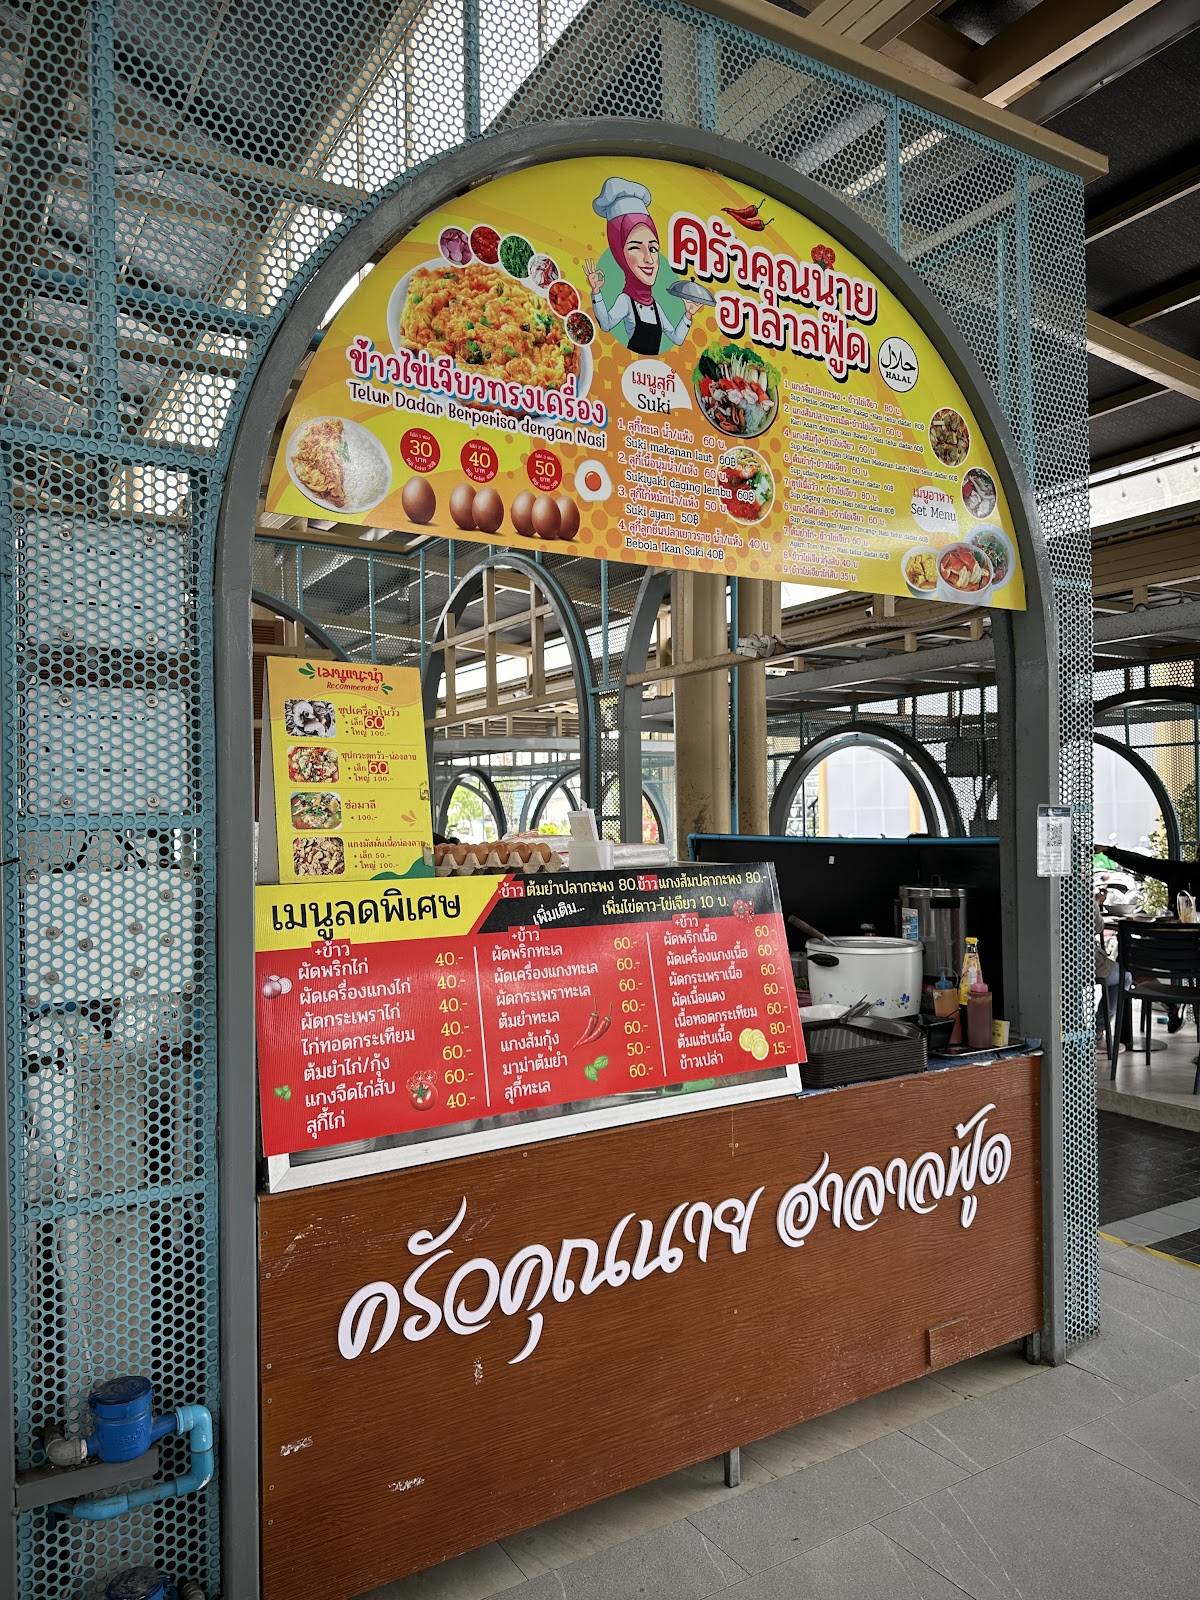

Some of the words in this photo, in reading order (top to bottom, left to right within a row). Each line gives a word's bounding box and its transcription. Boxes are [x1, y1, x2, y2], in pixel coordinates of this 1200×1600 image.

[673, 217, 873, 316] ครัวคุณนาย
[720, 296, 866, 374] ฮาลาลฟู๊ด
[881, 344, 917, 371] حلال
[350, 339, 606, 424] ข้าวไข่เจียวทรงเครื่อง
[632, 369, 676, 397] เมนูสุกี้
[886, 371, 912, 384] HALAL
[350, 382, 390, 405] Telur
[396, 392, 443, 416] Dadar
[449, 403, 516, 430] Berperisa
[521, 420, 572, 442] dengan
[577, 431, 606, 449] Nasi
[637, 394, 671, 414] Suki
[820, 401, 838, 410] dengan
[628, 417, 659, 435] สุกี้ทะเล
[662, 422, 693, 443] น้ำ/แห้ง
[703, 436, 714, 447] 60
[410, 439, 432, 457] 30
[469, 451, 491, 468] 40
[626, 437, 646, 450] Suki
[650, 443, 692, 459] makanan
[695, 450, 713, 463] laut
[535, 460, 555, 477] 50
[704, 469, 716, 479] 60
[626, 471, 666, 487] Sukiyaki
[669, 478, 700, 494] daging
[704, 484, 731, 497] lembu
[914, 487, 954, 504] เมนูอาหาร
[618, 486, 627, 496] 3.
[705, 501, 716, 511] 50
[626, 504, 646, 516] Suki
[650, 509, 675, 521] ayam
[911, 503, 928, 516] Set
[930, 506, 956, 521] Menu
[618, 519, 625, 530] 4.
[749, 539, 760, 549] 40
[626, 537, 658, 551] Bebola
[661, 542, 681, 554] Ikan
[684, 546, 704, 557] Suki
[317, 666, 384, 684] เมนูแนะนำ
[326, 681, 380, 692] Recommended
[364, 716, 384, 729] 60
[368, 761, 389, 774] 60
[527, 879, 614, 896] ต้มยำปลากะพง
[638, 875, 658, 891] ข้าว
[659, 873, 742, 889] แกงส้มปลากะพง
[745, 872, 767, 884] 80.-
[272, 888, 461, 941] เมนูลดพิเศษ
[532, 901, 585, 926] เพิ่มเติม...
[602, 895, 697, 916] เพิ่มไข่ดาว-ไข่เจียว
[700, 896, 714, 909] 10
[718, 897, 729, 908] บ.
[675, 913, 698, 928] +ข้าว
[512, 926, 540, 942] +ข้าว
[663, 923, 718, 946] ผัดพริกเนื้อ
[754, 925, 776, 937] 60.-
[314, 940, 350, 958] +ข้าว
[492, 942, 563, 962] ผัดพริกทะเล
[614, 936, 637, 950] 60.-
[666, 941, 748, 967] ผัดเครื่องแกงเนื้อ
[758, 944, 778, 956] 60.-
[298, 957, 369, 981] ผัดพริกไก่
[435, 951, 464, 967] 40.-
[494, 960, 598, 985] ผัดเครื่องแกงทะเล
[616, 957, 640, 971] 60.-
[668, 962, 743, 987] ผัดกระเพราเนื้อ
[760, 963, 781, 976] 60.-
[300, 978, 411, 1006] ผัดเครื่องแกงไก่
[437, 975, 466, 991] 40.-
[496, 983, 591, 1007] ผัดกระเพราทะเล
[619, 978, 644, 992] 60.-
[671, 985, 726, 1008] ผัดเนื้อแดง
[763, 982, 785, 995] 60.-
[301, 1002, 401, 1031] ผัดกระเพราไก่
[439, 998, 468, 1013] 40.-
[498, 1008, 560, 1030] ต้มยำทะเล
[621, 999, 646, 1013] 60.-
[674, 1003, 758, 1028] เนื้อทอดกระเทียม
[766, 1002, 788, 1015] 60.-
[301, 1026, 416, 1056] ไก่ทอดกระเทียม
[441, 1021, 470, 1037] 40.-
[500, 1028, 560, 1053] แกงส้มกุ้ง
[624, 1020, 649, 1035] 60.-
[677, 1024, 733, 1049] ต้มแซ่บเนื้อ
[769, 1021, 791, 1035] 80.-
[303, 1052, 390, 1082] ต้มยำไก่/กุ้ง
[442, 1044, 472, 1061] 60.-
[502, 1051, 568, 1076] มาม่าต้มยำ
[627, 1042, 651, 1057] 50.-
[679, 1051, 724, 1070] ข้าวเปล่า
[773, 1041, 792, 1055] 15.-
[305, 1078, 396, 1108] แกงจืดไก่สับ
[444, 1068, 474, 1085] 60.-
[504, 1075, 551, 1105] สุกี้ทะเล
[629, 1063, 654, 1078] 60.-
[306, 1107, 346, 1140] สุกี้ไก่
[446, 1092, 476, 1109] 40.-
[777, 1104, 1011, 1248] ฮาลาลฟู้ด
[337, 1185, 765, 1366] ครัวคุณนาย
